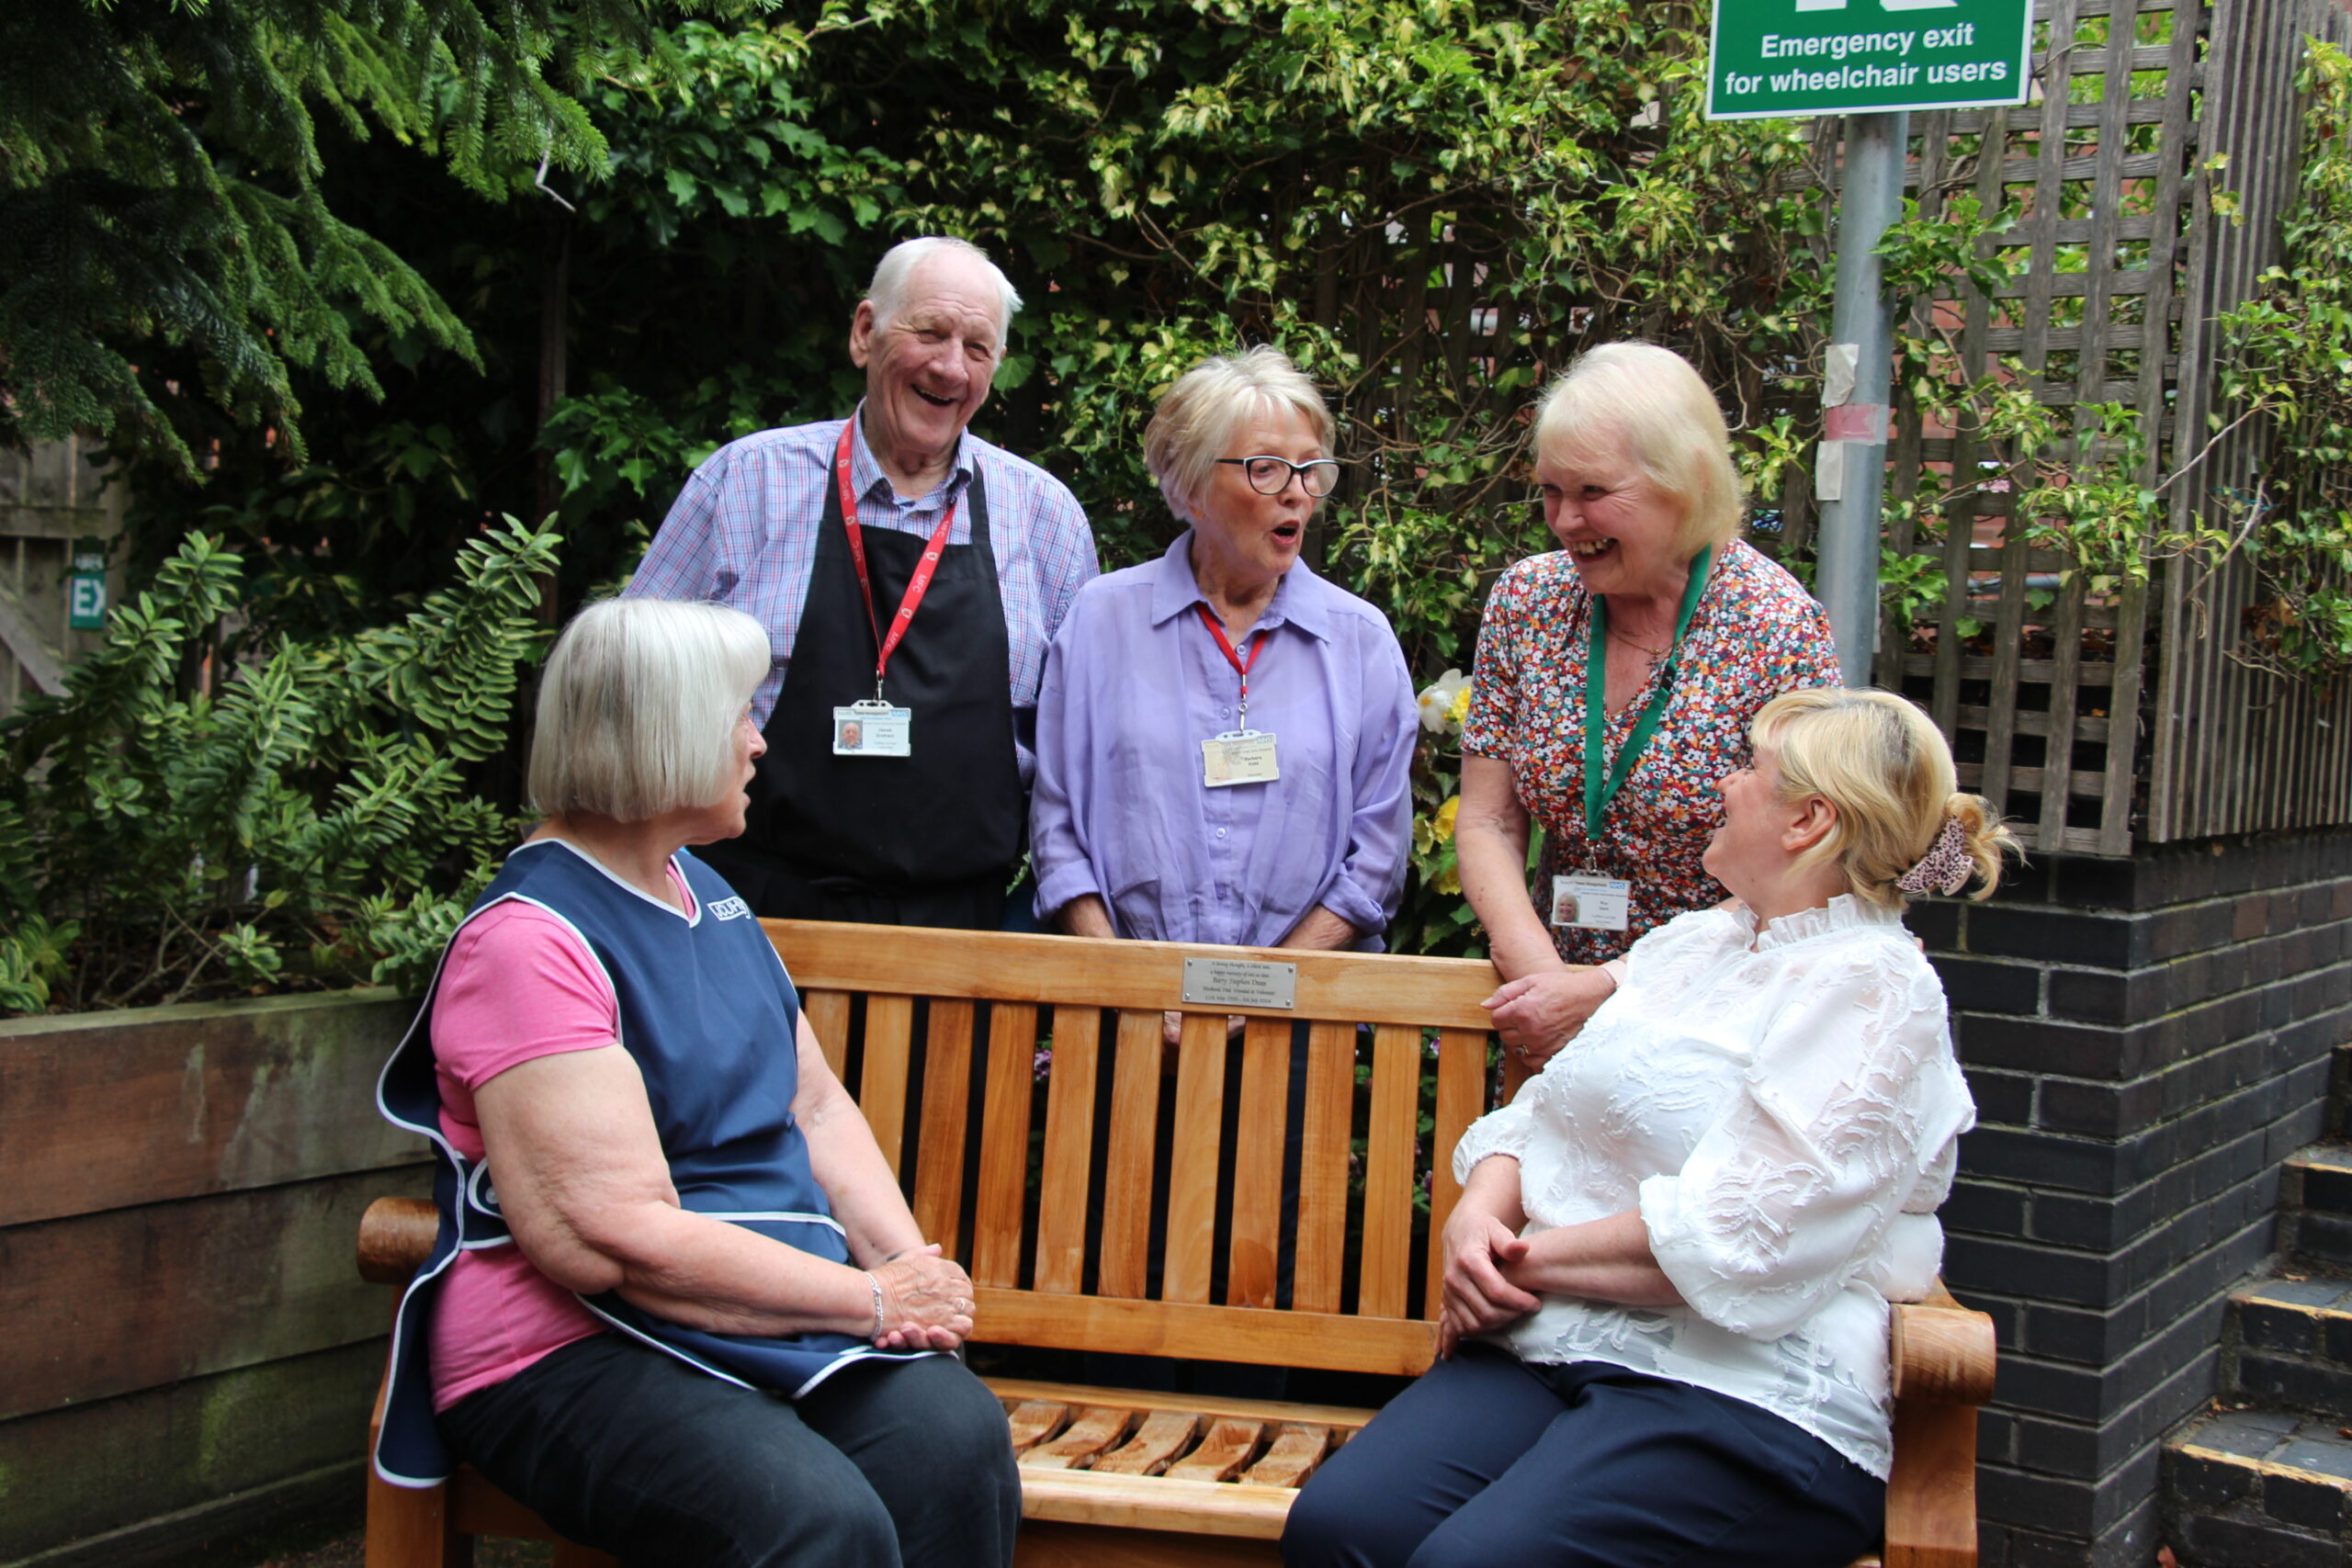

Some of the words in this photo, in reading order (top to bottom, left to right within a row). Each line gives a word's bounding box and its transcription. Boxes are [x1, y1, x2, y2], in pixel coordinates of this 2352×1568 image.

[1760, 30, 1915, 60] Emergency
[1922, 22, 1974, 49] exit
[1724, 72, 1762, 95] for
[1770, 62, 1919, 92] wheelchair
[1928, 61, 2007, 85] users
[912, 573, 927, 594] MFC
[1610, 881, 1625, 889] NHS
